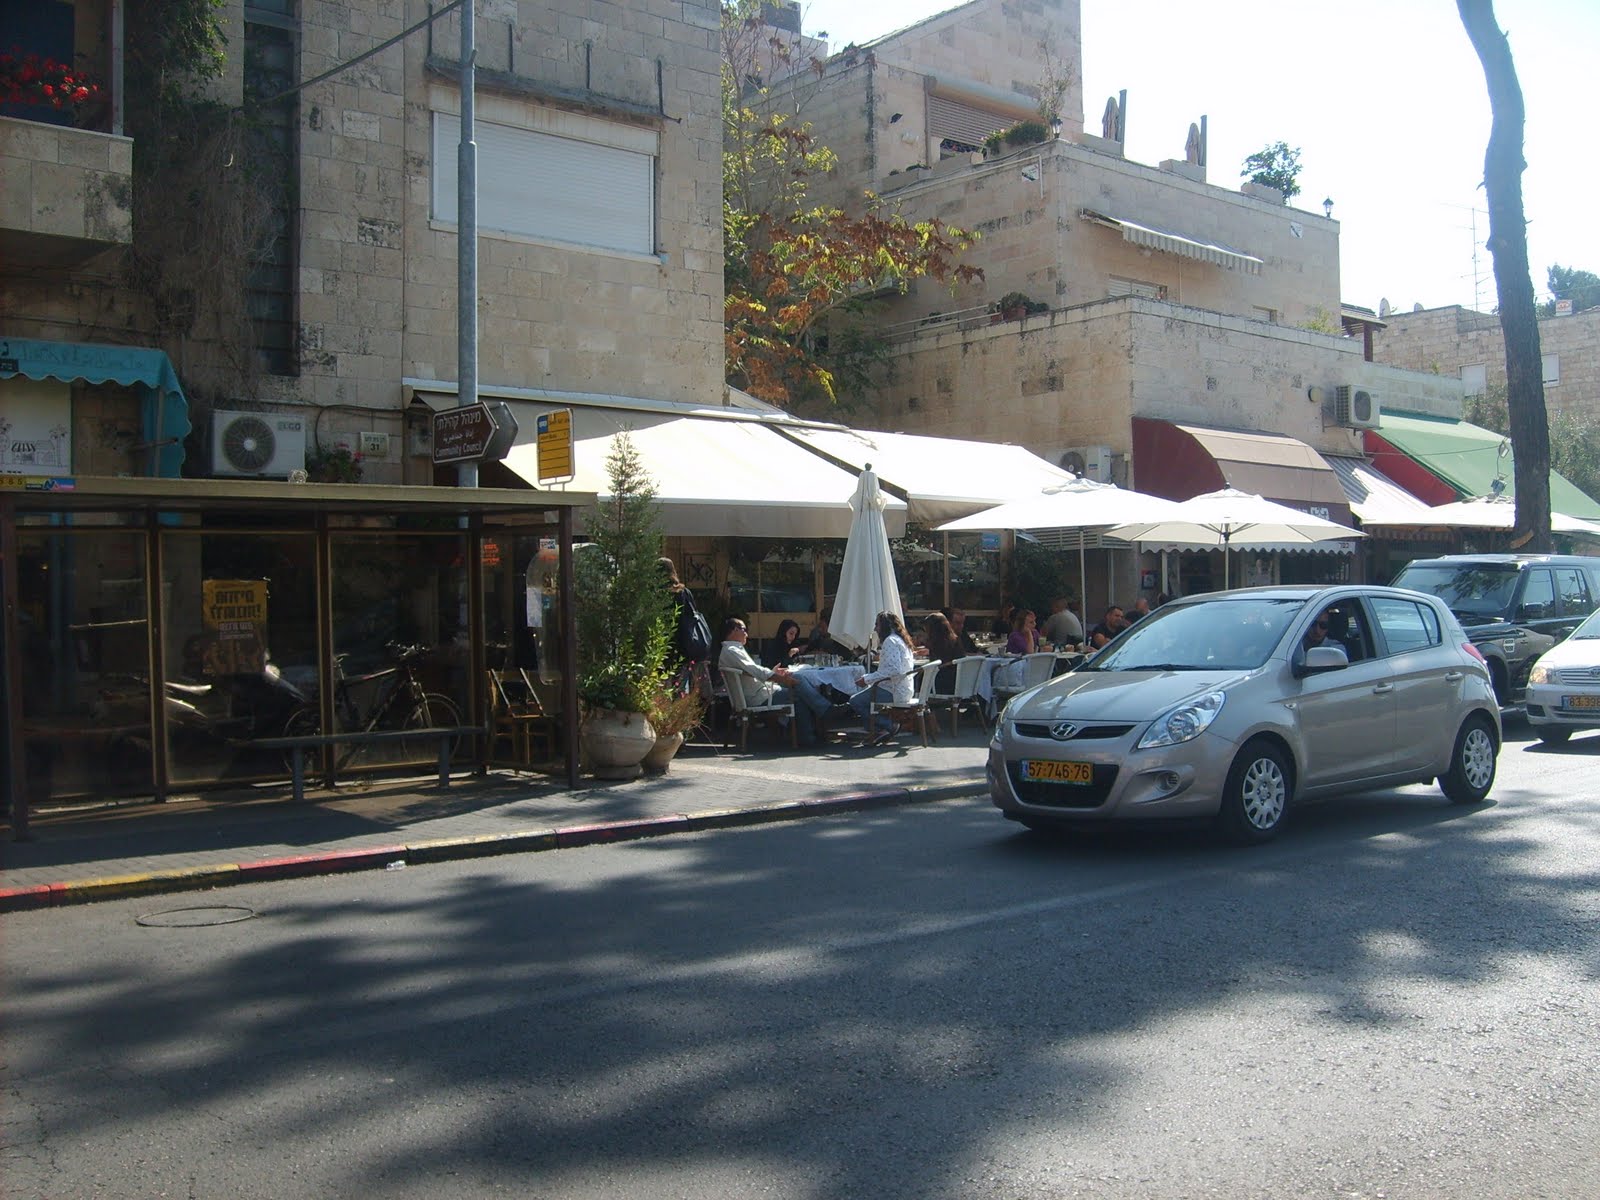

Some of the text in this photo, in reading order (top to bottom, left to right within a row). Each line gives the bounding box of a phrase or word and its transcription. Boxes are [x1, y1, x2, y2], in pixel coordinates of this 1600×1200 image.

[370, 443, 380, 451] 31
[435, 441, 482, 457] Community Council
